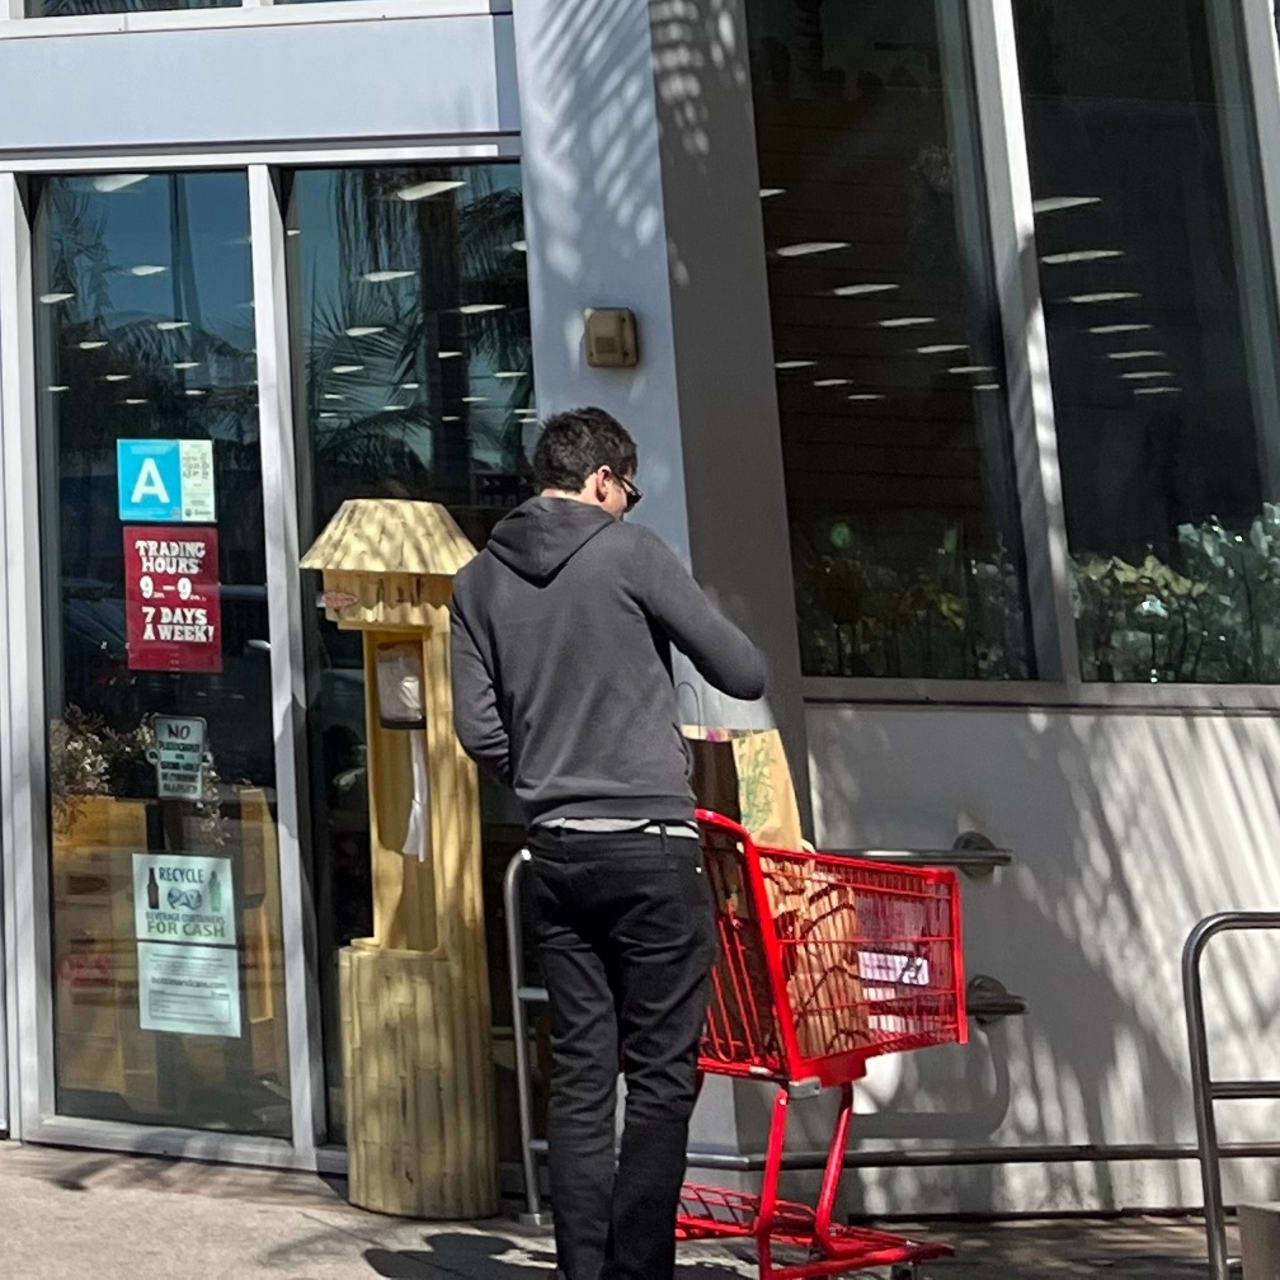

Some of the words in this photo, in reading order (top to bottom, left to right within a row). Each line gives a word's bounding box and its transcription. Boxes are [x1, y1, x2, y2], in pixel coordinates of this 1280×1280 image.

[130, 457, 171, 504] A
[135, 540, 206, 558] TRADING
[141, 606, 156, 624] 7
[160, 606, 208, 625] DAYS
[143, 623, 156, 641] A
[157, 624, 215, 643] WEEK!
[167, 724, 192, 740] NO
[158, 866, 204, 883] RECYCLE
[147, 921, 178, 936] FOR
[182, 923, 225, 938] CASH
